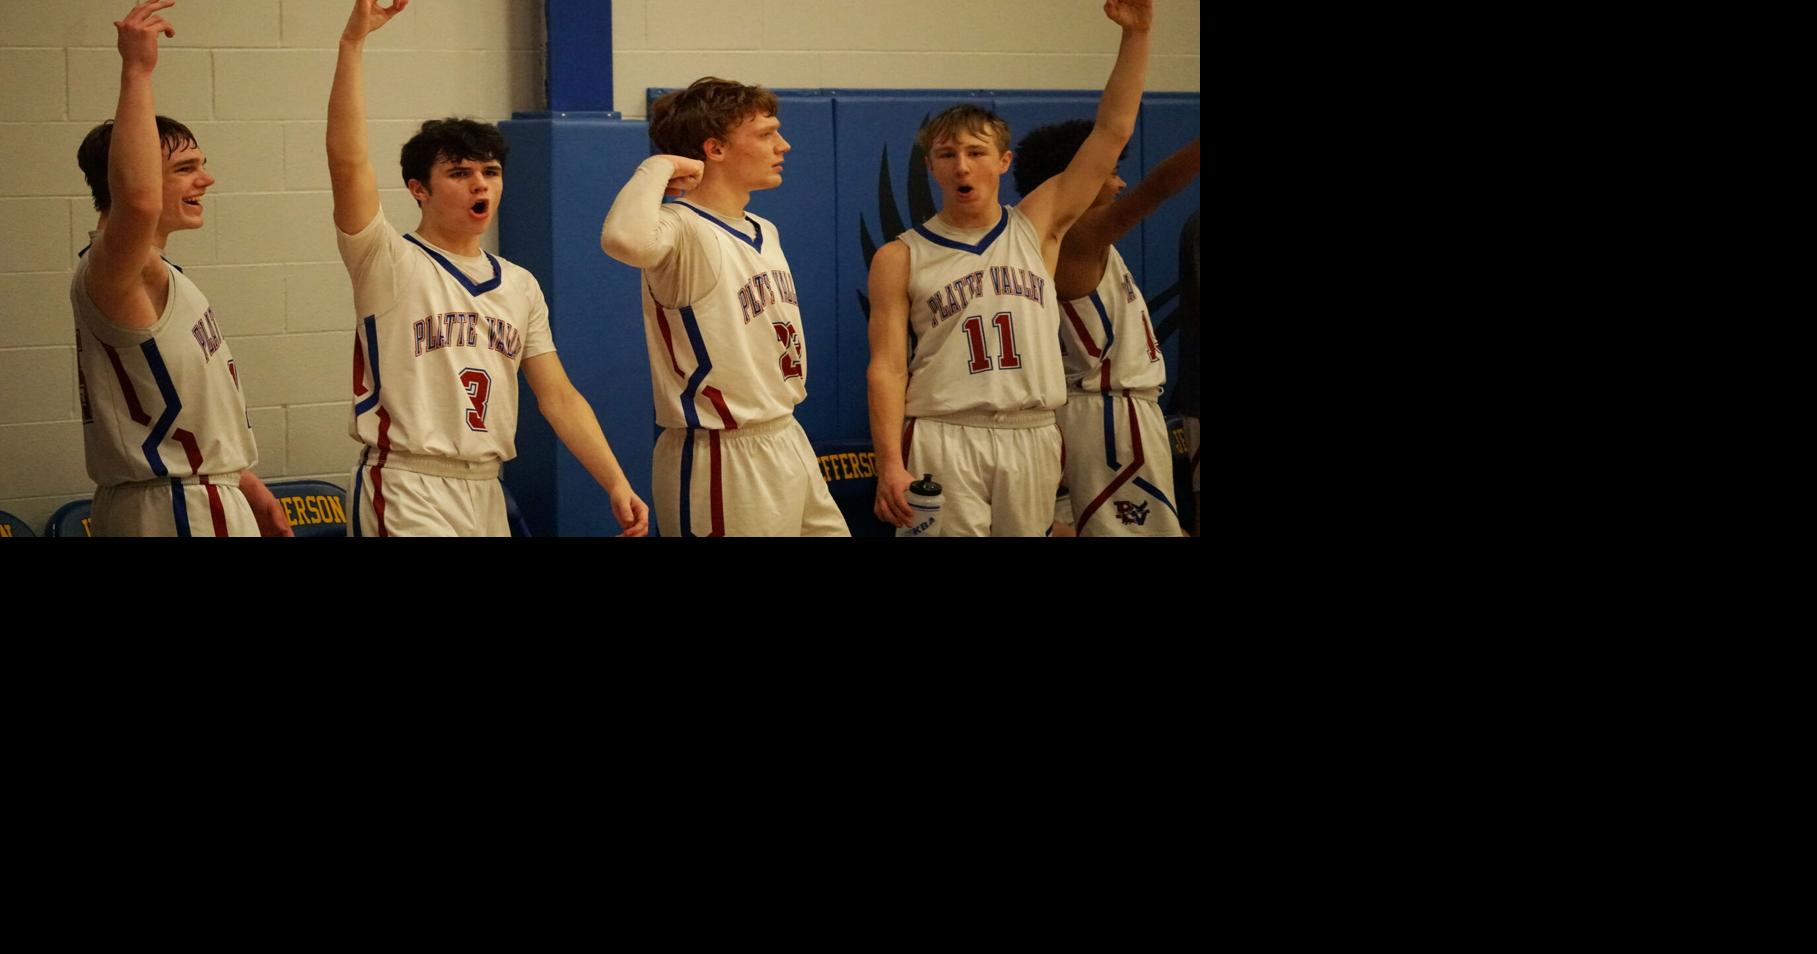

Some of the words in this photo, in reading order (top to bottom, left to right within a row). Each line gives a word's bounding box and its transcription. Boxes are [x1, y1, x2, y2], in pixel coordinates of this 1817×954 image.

[990, 265, 1045, 309] VALLEY
[962, 311, 1022, 374] 11
[458, 367, 492, 433] 3
[279, 495, 347, 527] ERSON
